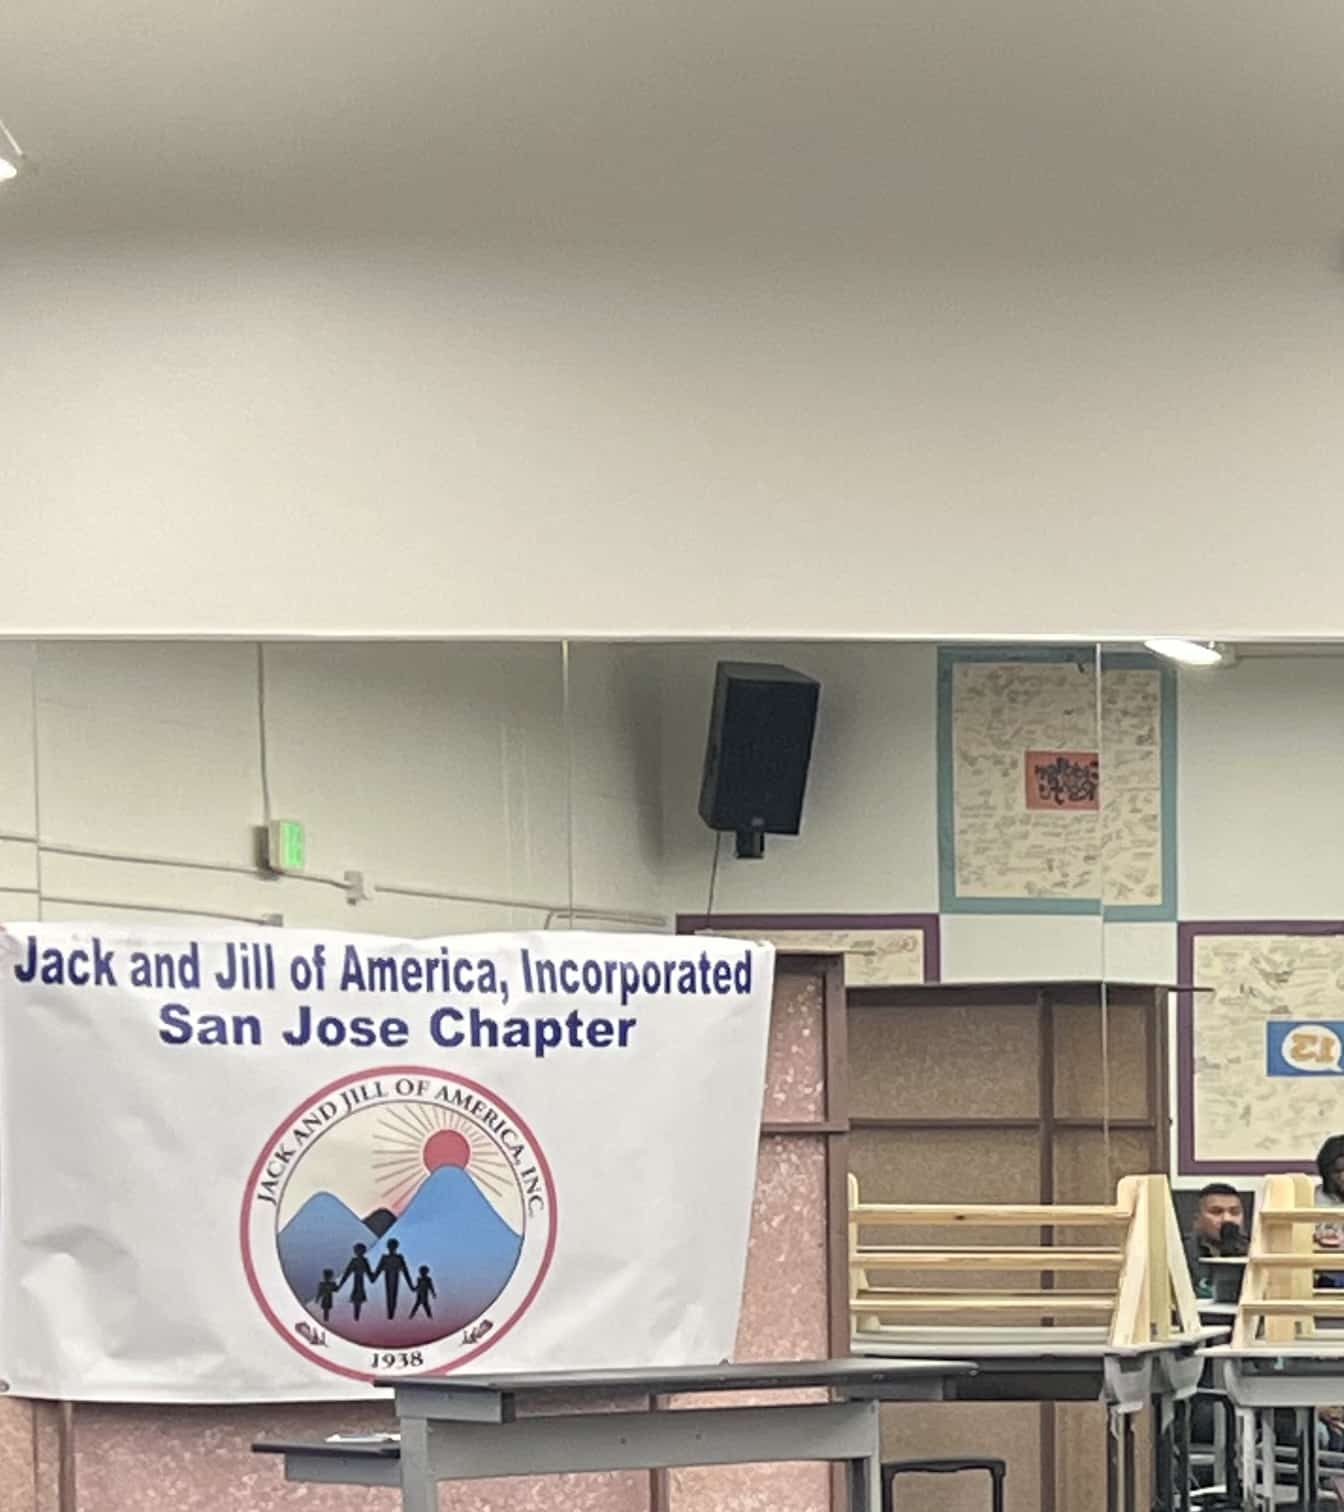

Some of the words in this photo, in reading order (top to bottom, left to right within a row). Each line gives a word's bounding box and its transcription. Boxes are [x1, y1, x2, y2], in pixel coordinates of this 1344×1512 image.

[14, 936, 117, 987] Jack
[130, 941, 200, 989] and
[215, 942, 275, 990] Jill
[290, 944, 326, 991] of
[340, 944, 509, 1005] America,
[520, 948, 752, 1006] Incorporated
[159, 1003, 262, 1046] San
[282, 1005, 409, 1048] Jose
[430, 1006, 637, 1058] Chapter
[257, 1146, 296, 1205] JACK
[292, 1101, 338, 1147] AND
[340, 1080, 388, 1112] JILL
[395, 1078, 431, 1097] OF
[433, 1085, 522, 1166] AMERICA,
[371, 1350, 424, 1369] 1938
